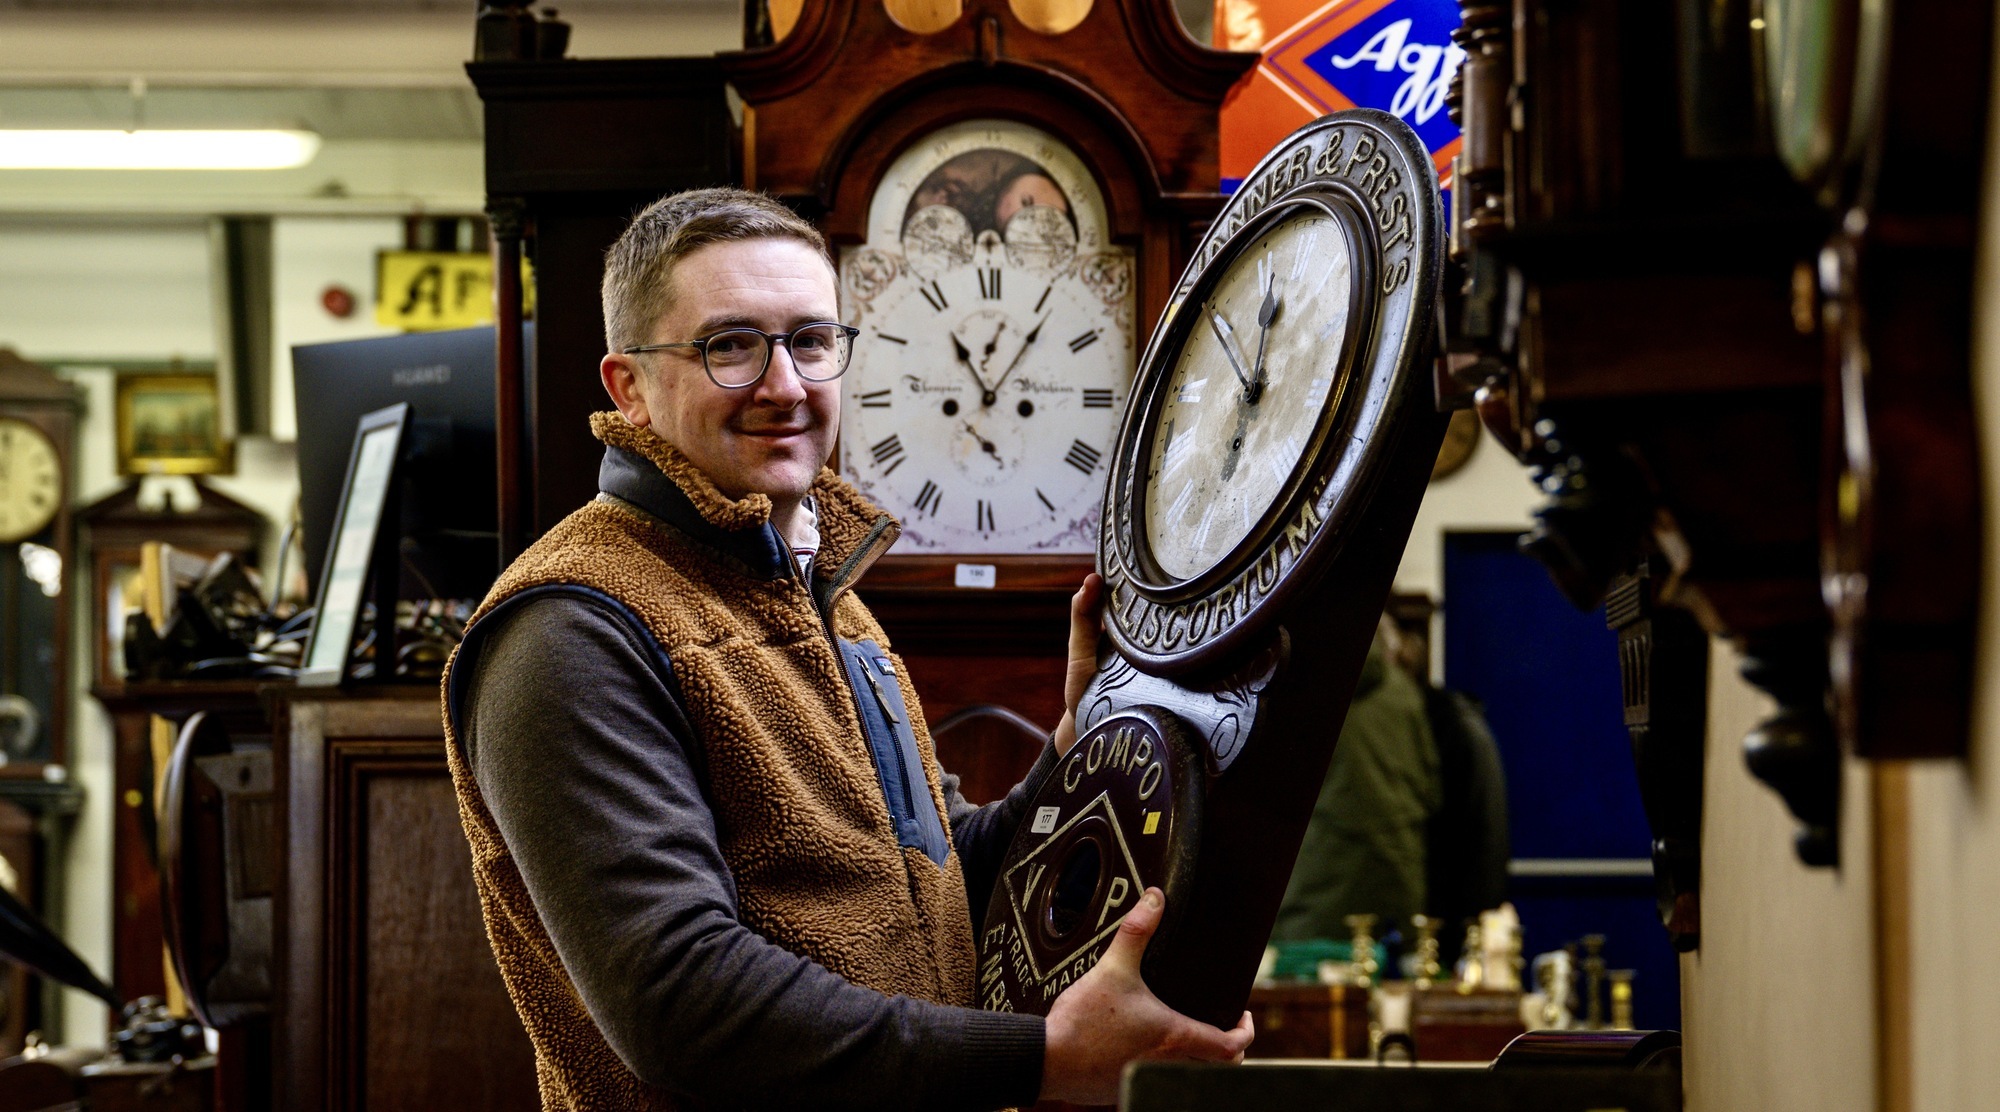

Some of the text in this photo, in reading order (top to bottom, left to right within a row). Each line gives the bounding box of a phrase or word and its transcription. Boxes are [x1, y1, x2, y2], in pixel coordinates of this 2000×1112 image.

[1331, 18, 1466, 125] Agf
[1315, 129, 1344, 176] &
[1041, 814, 1053, 824] 177
[1022, 862, 1129, 932] V P
[1007, 926, 1099, 1000] TRADE MARK
